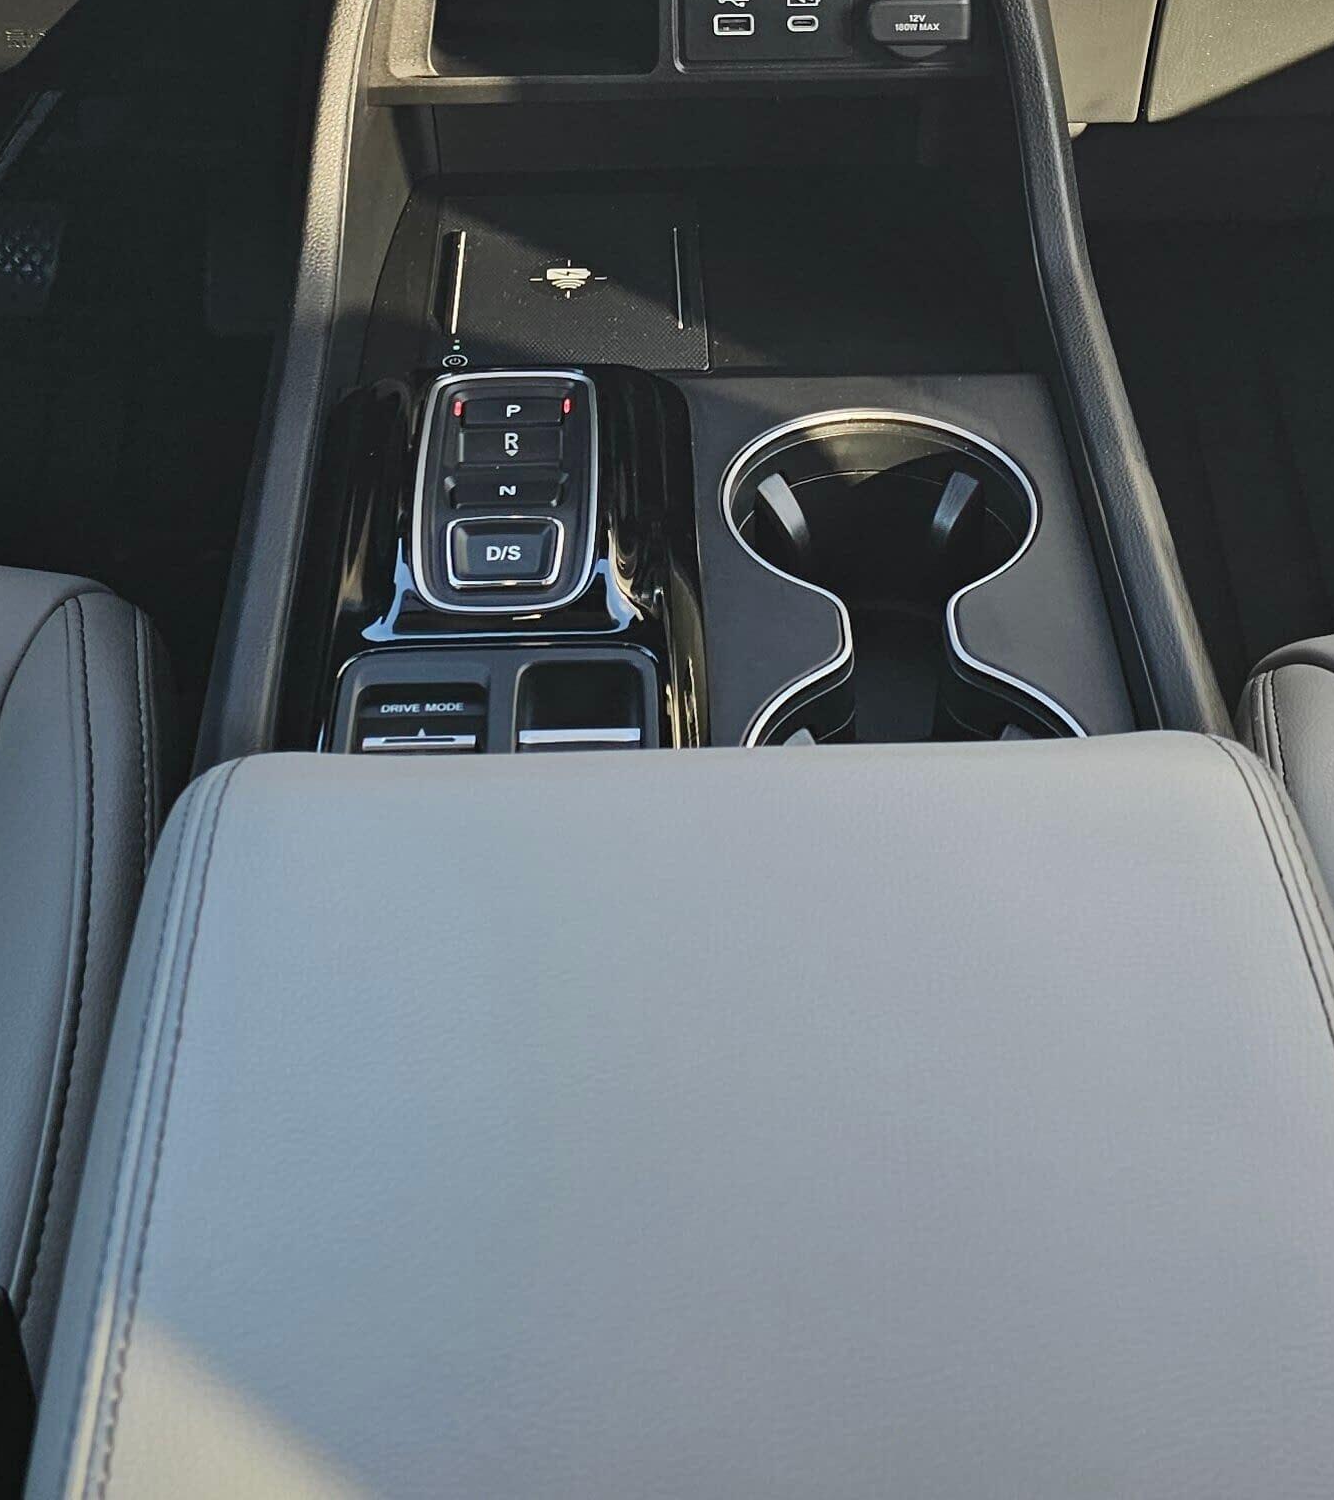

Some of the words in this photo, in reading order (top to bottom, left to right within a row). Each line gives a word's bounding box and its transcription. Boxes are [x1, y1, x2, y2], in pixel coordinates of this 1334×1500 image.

[909, 14, 926, 22] 12V
[895, 23, 918, 32] 180W
[919, 23, 940, 31] MAX
[506, 404, 522, 418] P
[504, 432, 519, 450] R
[499, 485, 517, 496] N
[485, 545, 522, 561] D/S
[380, 703, 420, 713] DRIVE
[424, 702, 464, 712] MODE
